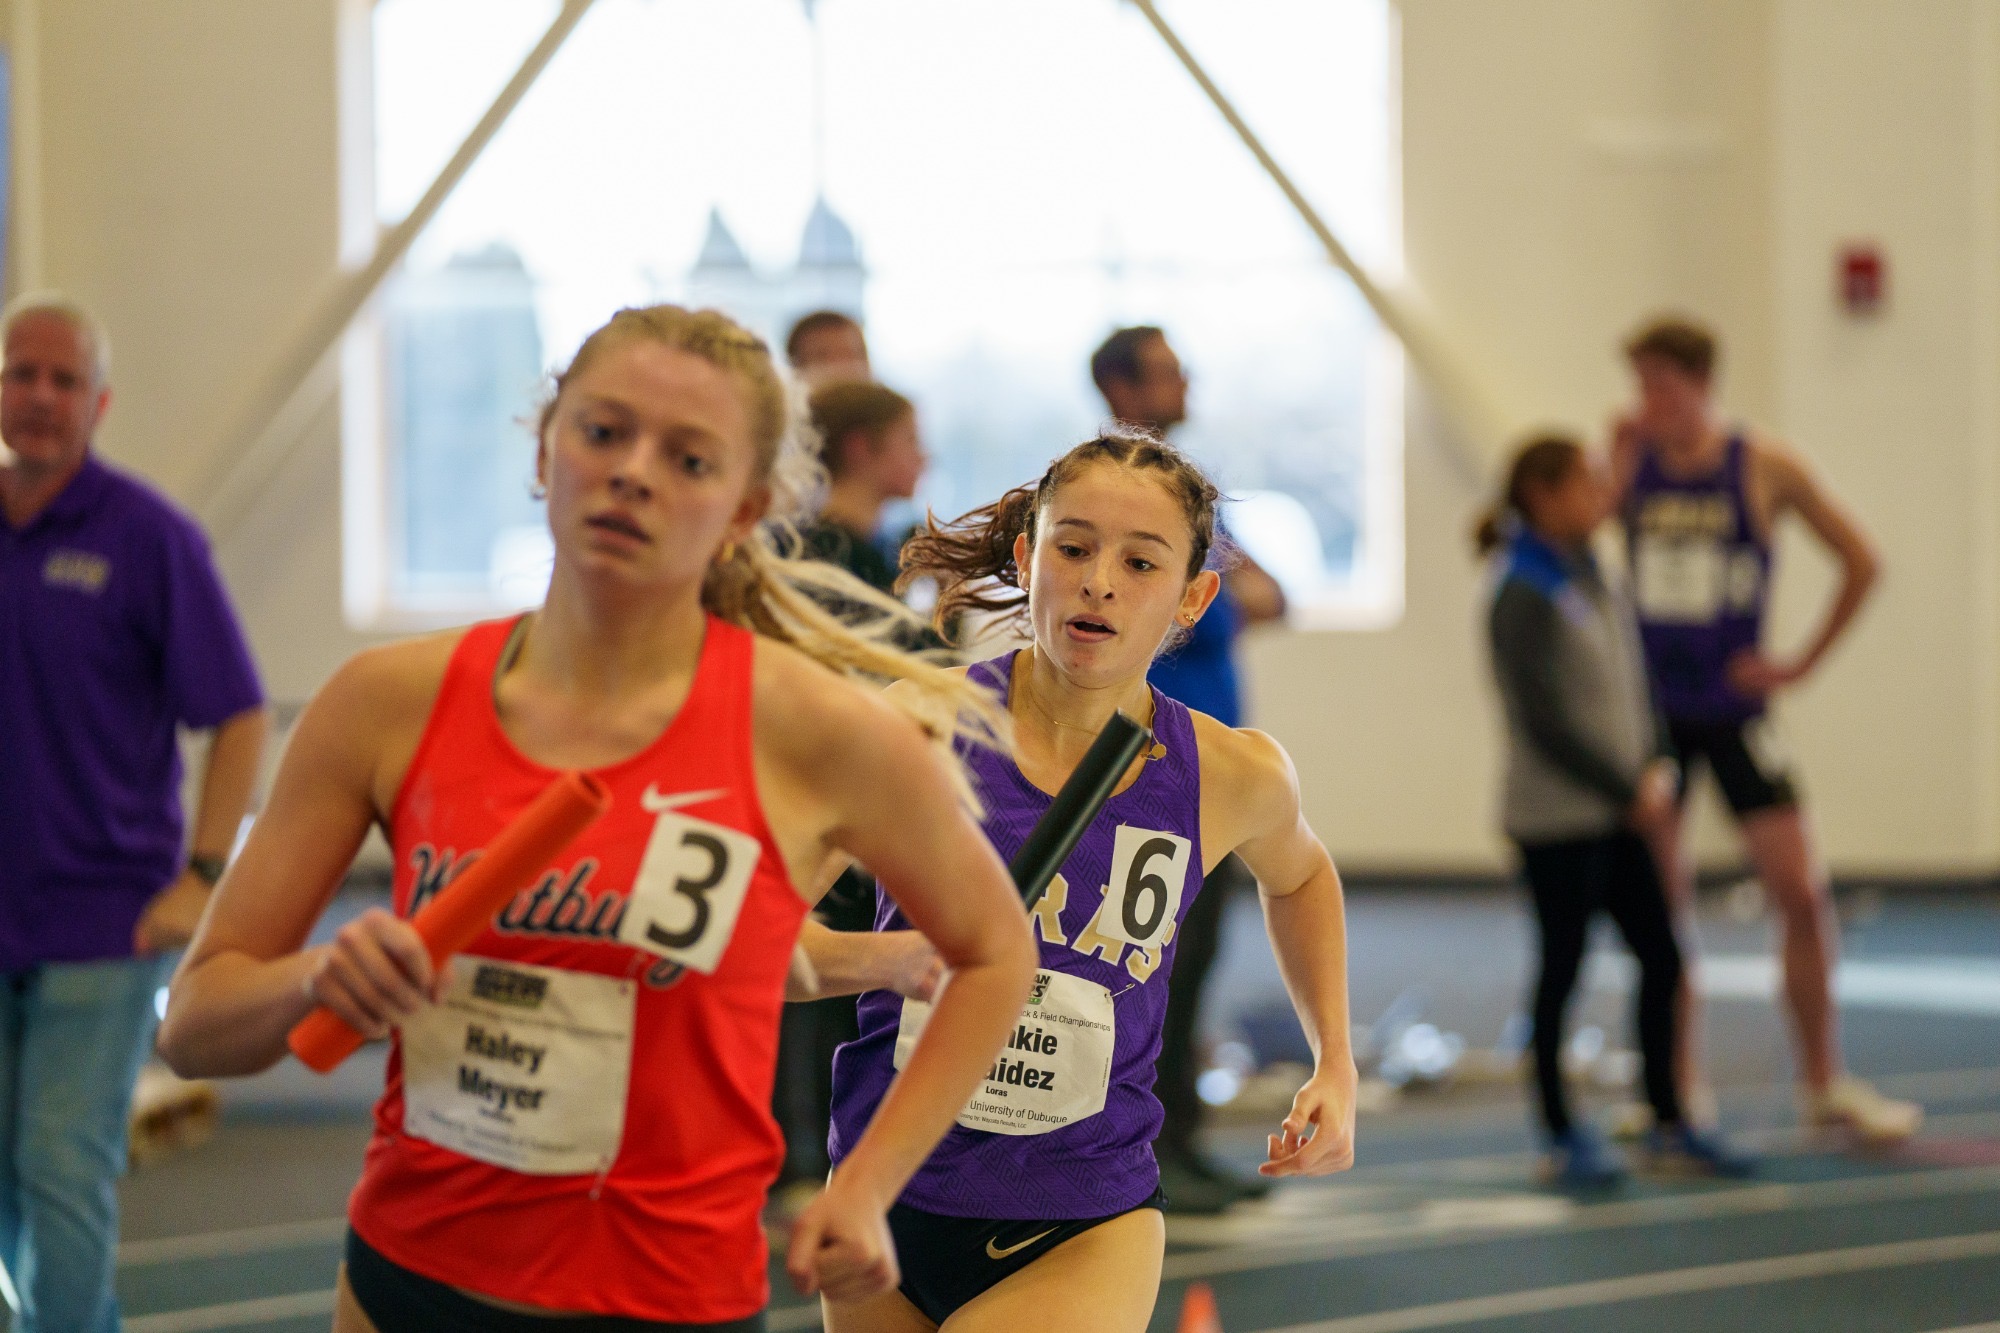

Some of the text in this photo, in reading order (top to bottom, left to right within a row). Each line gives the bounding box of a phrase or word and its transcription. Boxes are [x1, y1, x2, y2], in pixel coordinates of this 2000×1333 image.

[646, 831, 730, 950] 3
[1121, 837, 1178, 941] 6
[1032, 1010, 1039, 1019] &
[1040, 1011, 1057, 1022] Field
[1058, 1015, 1111, 1032] Championships
[465, 1023, 547, 1076] Haley
[457, 1063, 545, 1111] Meyer
[985, 1085, 1008, 1097] Loras
[970, 1099, 1068, 1125] University of Dubuque
